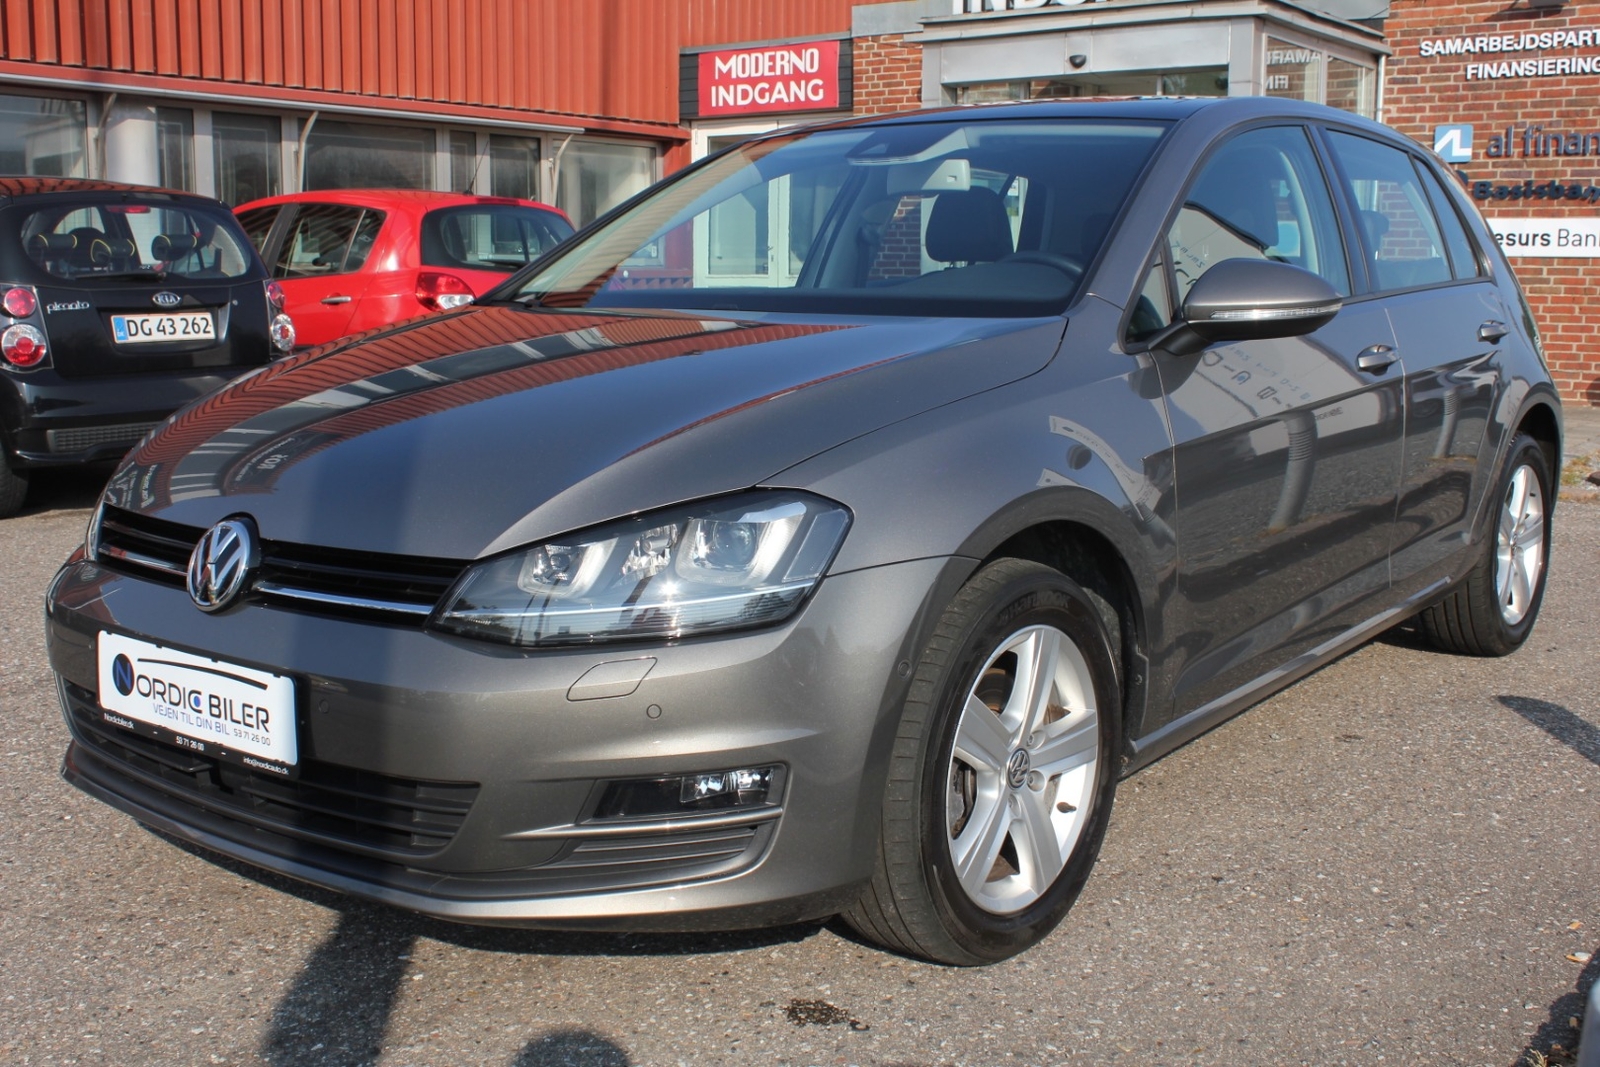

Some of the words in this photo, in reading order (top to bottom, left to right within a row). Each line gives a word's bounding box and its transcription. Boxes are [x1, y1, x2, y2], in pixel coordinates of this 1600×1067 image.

[714, 48, 820, 80] MODERNO
[711, 79, 824, 107] INDGANG
[1487, 125, 1514, 157] al
[1494, 233, 1551, 247] esurs
[1557, 228, 1600, 248] Ban
[126, 319, 153, 337] DG
[156, 318, 177, 335] 43
[180, 316, 211, 335] 262
[152, 703, 179, 721] VEJEN
[180, 711, 194, 725] TIL
[196, 716, 213, 731] DIN
[214, 721, 231, 736] BIL
[208, 693, 270, 733] BILER
